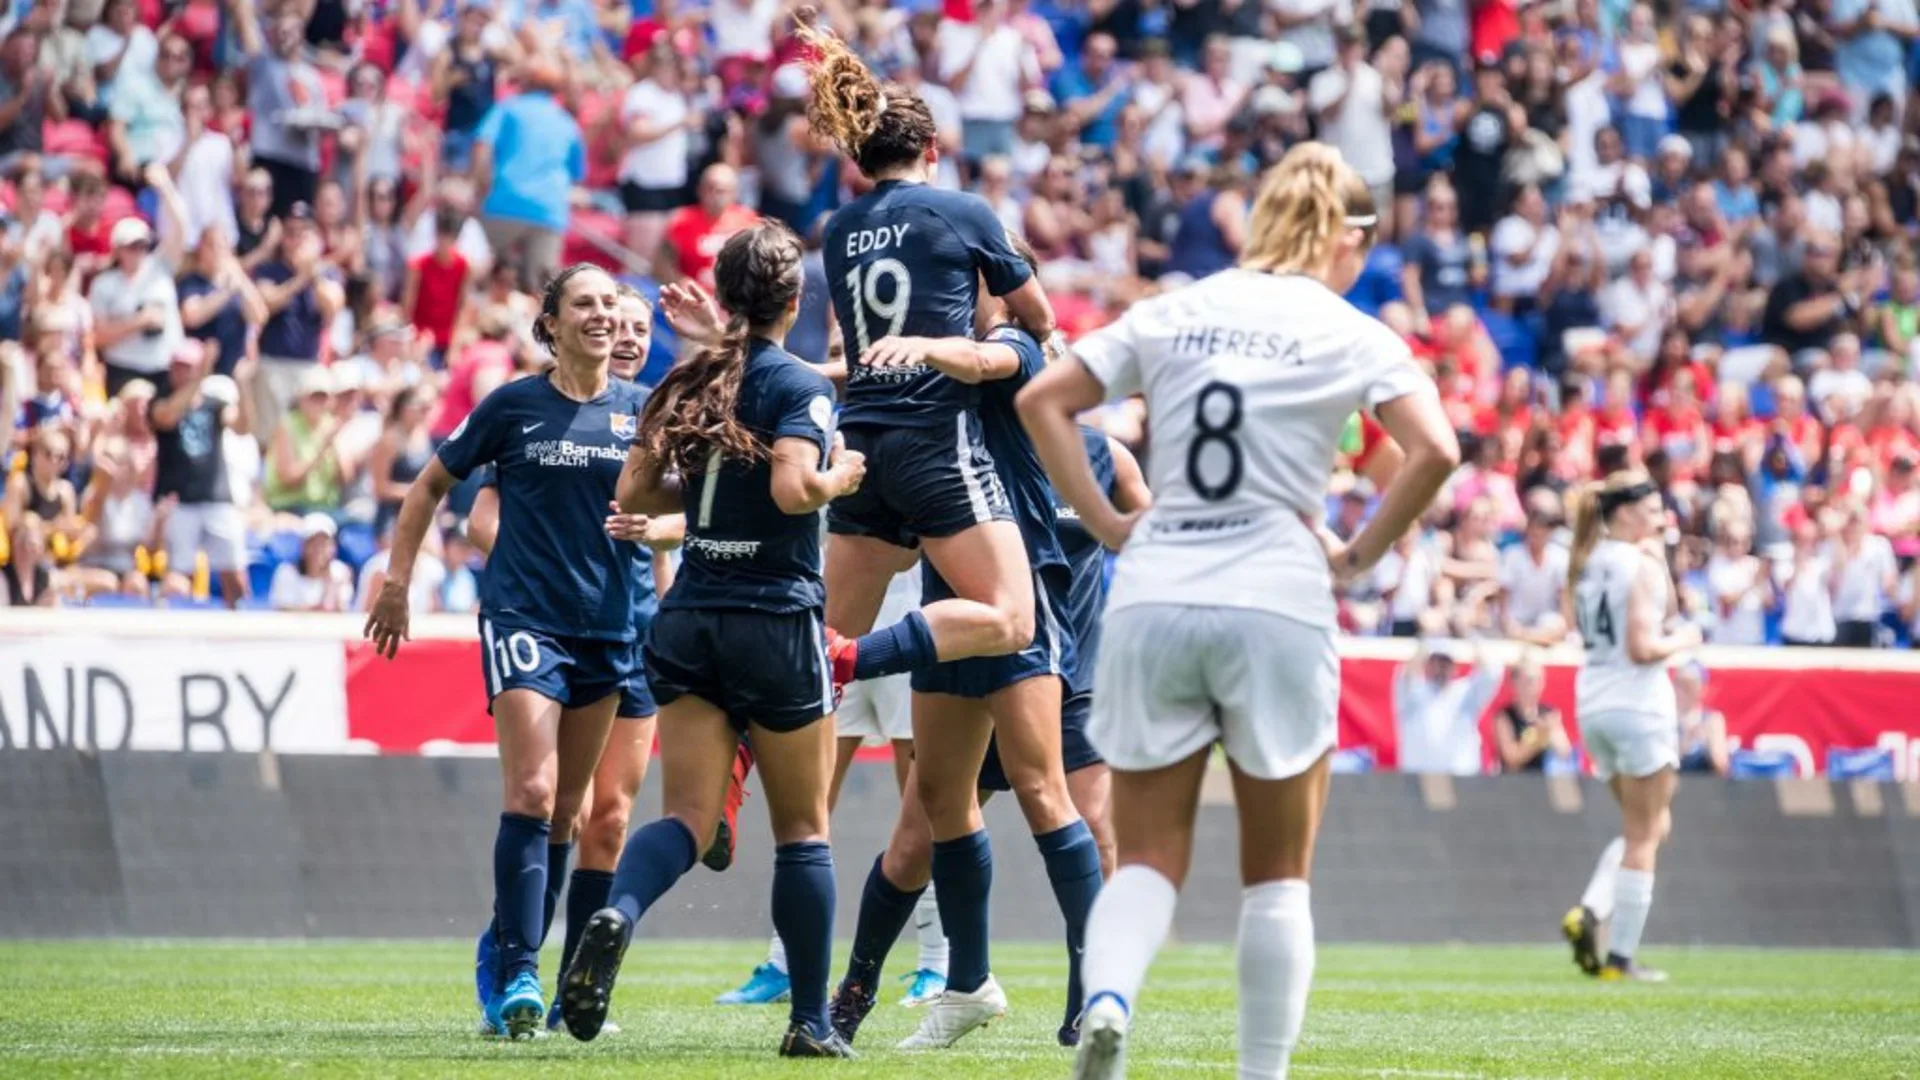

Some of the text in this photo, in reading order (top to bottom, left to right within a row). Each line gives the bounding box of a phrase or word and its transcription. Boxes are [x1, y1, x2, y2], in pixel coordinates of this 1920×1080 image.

[846, 223, 910, 257] EDDY
[846, 258, 912, 354] 19
[1172, 326, 1304, 365] THERESA
[539, 454, 588, 467] HEALTH
[1186, 380, 1244, 501] 8
[496, 631, 541, 677] 10
